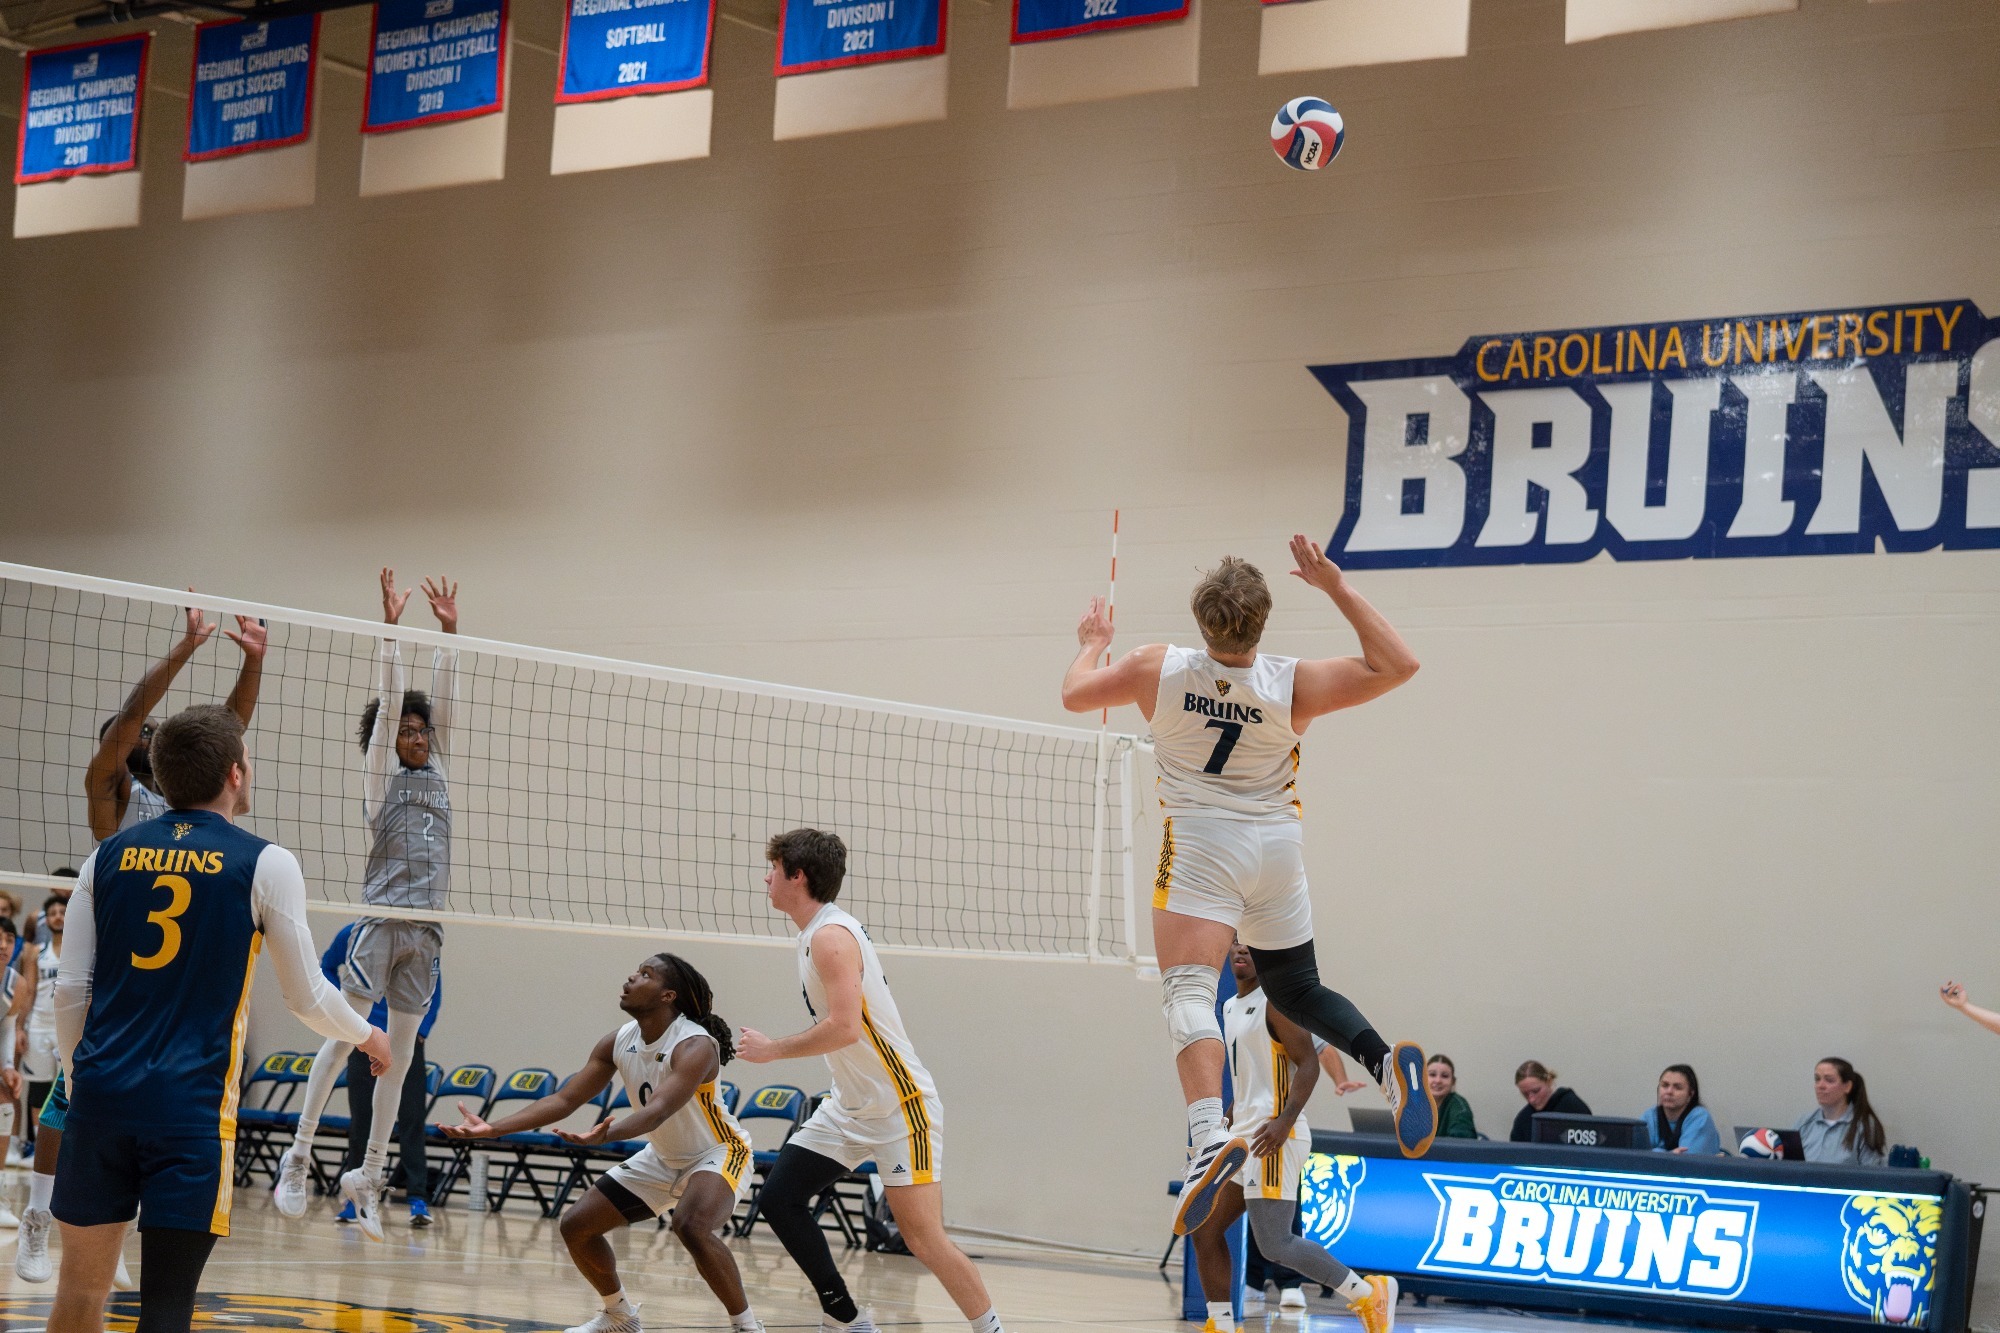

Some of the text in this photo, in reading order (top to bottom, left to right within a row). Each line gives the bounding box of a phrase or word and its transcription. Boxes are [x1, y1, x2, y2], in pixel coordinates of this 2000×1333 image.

[572, 0, 632, 17] REGIONAL
[827, 0, 895, 29] DIVISION I
[1083, 0, 1117, 19] 2022
[377, 10, 499, 51] REGIONAL CHAMPIONS
[606, 22, 666, 49] SOFTBALL
[842, 28, 874, 53] 2021
[198, 43, 308, 82] REGIONAL CHAMPIONS
[375, 33, 497, 74] WOMEN'S VOLLEYBALL
[212, 70, 286, 102] MEN'S SOCCER
[406, 64, 461, 92] DIVISION I
[618, 61, 647, 84] 2021
[30, 74, 136, 107] REGIONAL CHAMPIONS
[418, 90, 444, 114] 2019
[28, 96, 134, 129] WOMEN'S VOLLEYBALL
[222, 95, 273, 122] DIVISION I
[55, 123, 101, 146] DIVISION I
[1304, 141, 1319, 164] NCAA
[1475, 304, 1964, 383] CAROLINA UNIVERSITY
[1183, 692, 1263, 724] BRUINS
[1204, 718, 1244, 775] 7
[422, 812, 434, 842] 2
[119, 847, 224, 875] BRUINS
[131, 874, 192, 970] 3
[1567, 1129, 1597, 1146] POSS
[1500, 1179, 1700, 1215] CAROLINA UNIVERSITY
[1434, 1185, 1749, 1291] BRUINS
